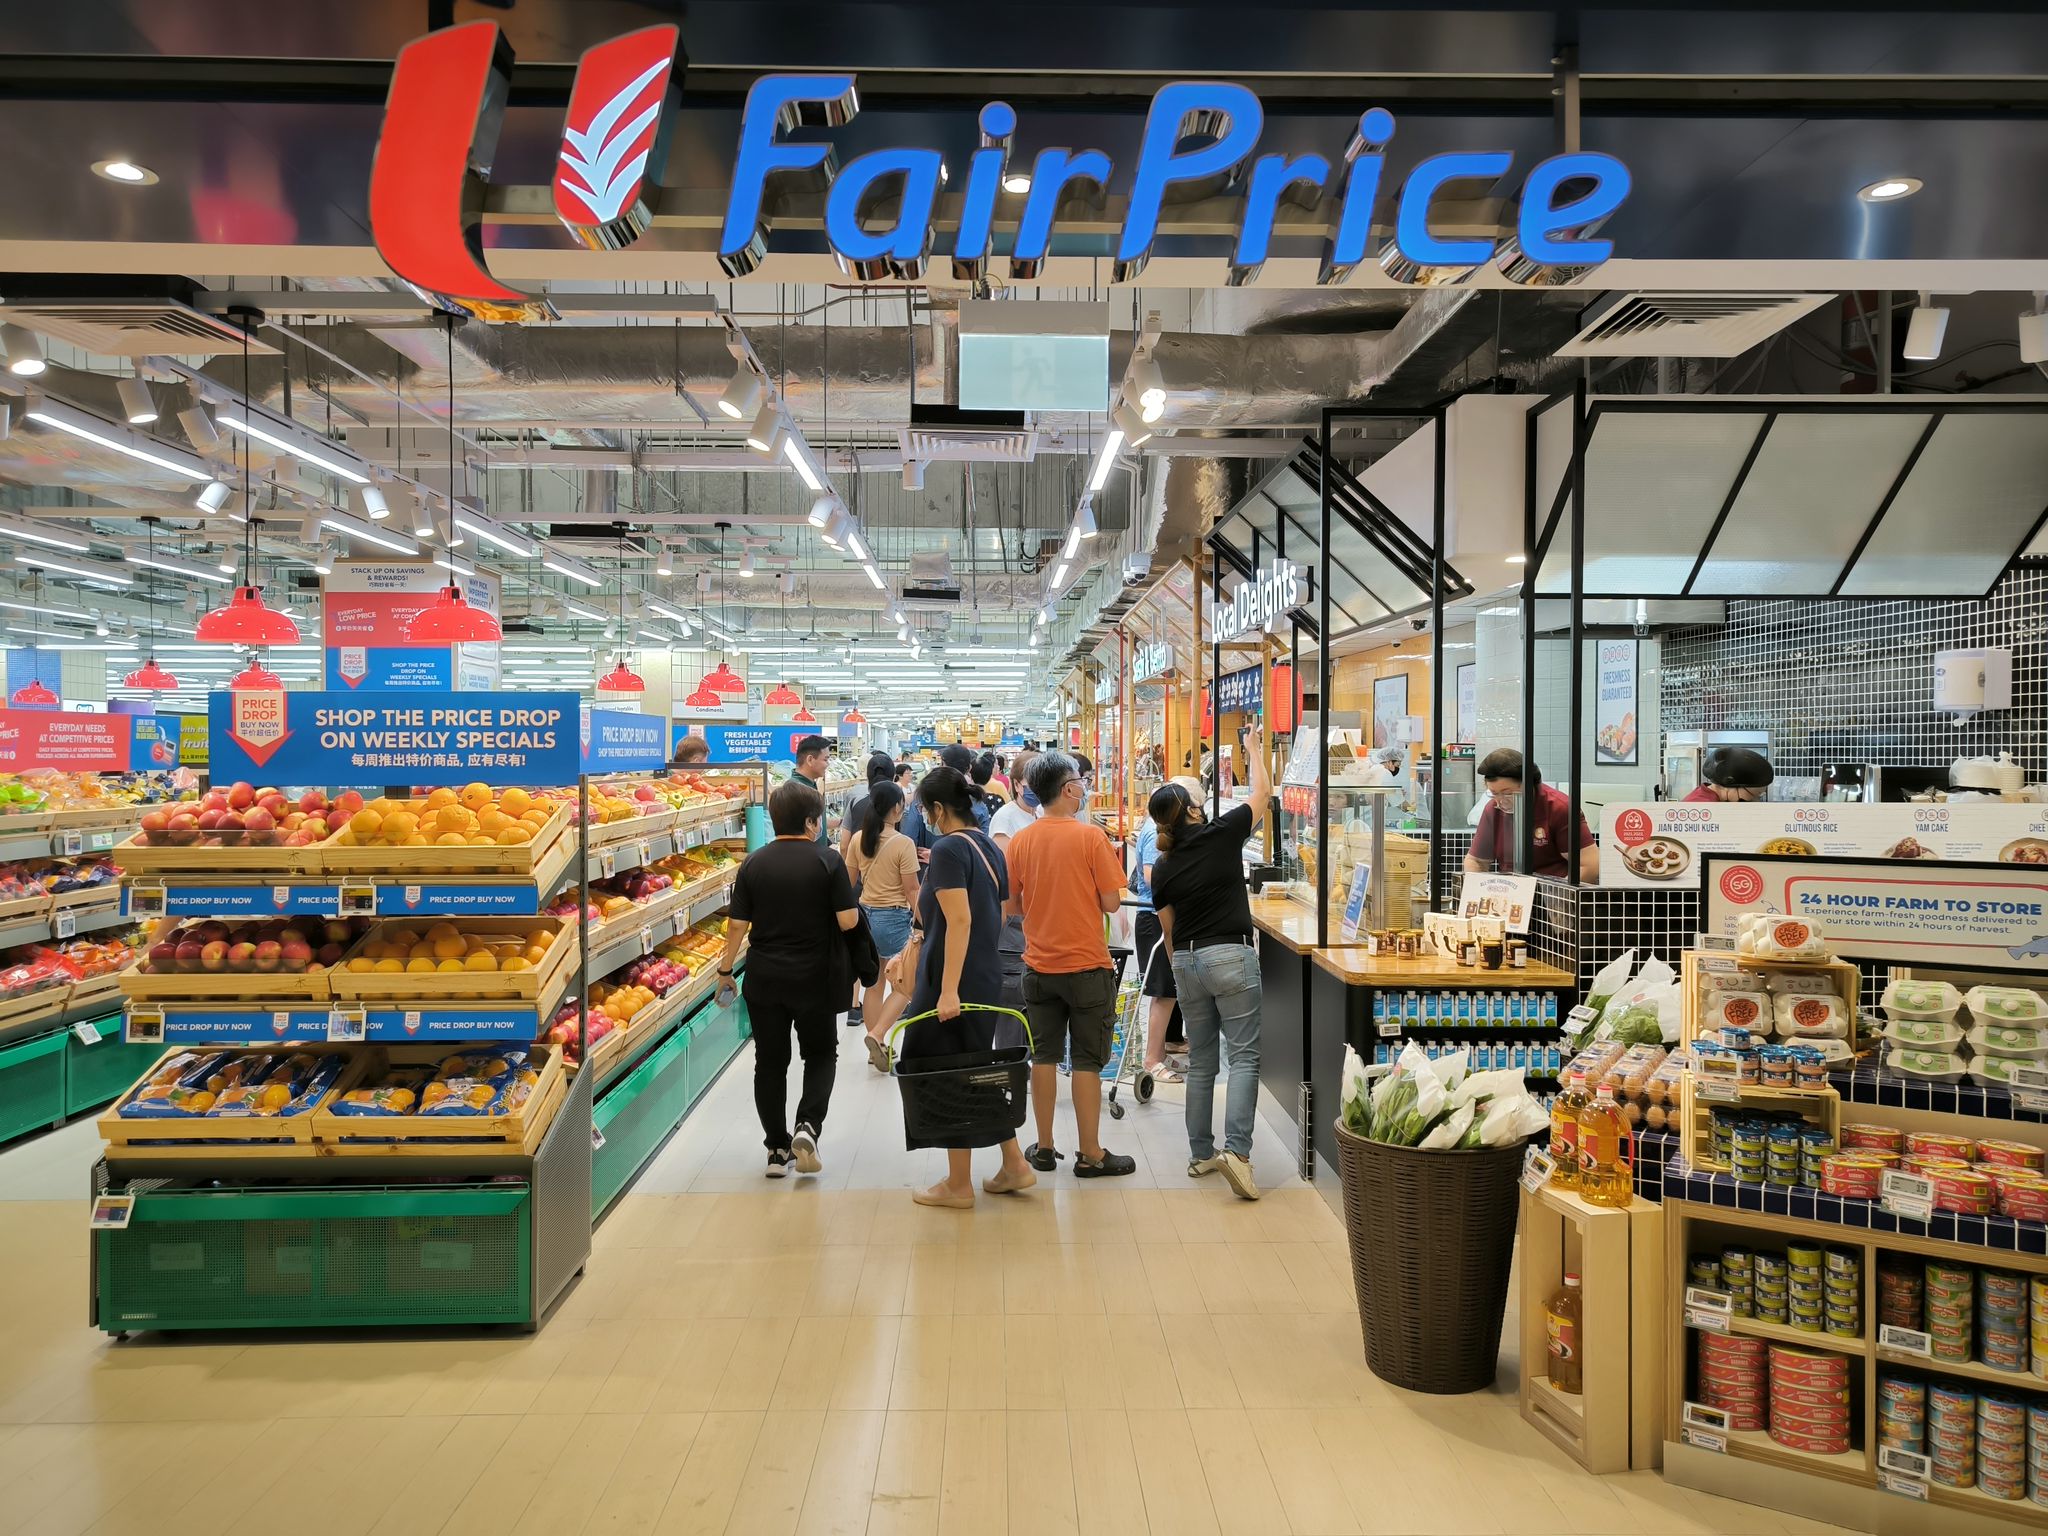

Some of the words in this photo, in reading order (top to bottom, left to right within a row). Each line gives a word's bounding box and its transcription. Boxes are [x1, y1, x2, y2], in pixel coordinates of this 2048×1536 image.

[717, 72, 1634, 275] FairPrice
[1212, 585, 1238, 644] Local
[1240, 558, 1297, 633] Delights
[339, 614, 356, 622] LOW
[357, 611, 377, 620] PRICE
[242, 699, 277, 709] PRICE
[242, 710, 278, 720] DROP
[315, 708, 376, 727] SHOP
[381, 708, 425, 727] THE
[431, 708, 492, 727] PRICE
[500, 708, 561, 727] DROP
[49, 723, 83, 733] EVERYDAY
[85, 724, 106, 733] NEEDS
[39, 734, 48, 743] AT
[49, 734, 92, 743] COMPETITIVE
[93, 735, 115, 744] PRICES
[320, 731, 356, 749] ON
[362, 731, 450, 749] WEEKLY
[456, 731, 556, 749] SPECIALS
[602, 727, 618, 743] PRICE
[620, 727, 634, 743] DROP
[635, 728, 645, 743] BUY
[645, 728, 659, 743] NOW
[351, 753, 464, 768] 每周推出特价商品,
[467, 753, 526, 767] 应有尽有!
[1657, 823, 1673, 833] JIAN
[1674, 823, 1683, 833] BO
[1684, 823, 1700, 833] SHUI
[1701, 823, 1720, 833] KUEH
[1784, 823, 1822, 833] GLUTINOUS
[1823, 823, 1838, 833] RICE
[1915, 823, 1930, 833] YAM
[1931, 823, 1949, 833] CAKE
[2029, 823, 2046, 833] CHEE
[1733, 879, 1750, 890] SG
[190, 897, 212, 905] DROP
[298, 896, 320, 904] PRICE
[1800, 893, 1822, 905] 24
[1827, 894, 1880, 908] HOUR
[1885, 896, 1938, 911] FARM
[1944, 899, 1971, 913] TO
[1976, 901, 2042, 916] STORE
[1804, 906, 1858, 917] Experience
[1861, 908, 1915, 919] farm-fresh
[1918, 911, 1969, 923] goodness
[1972, 913, 2022, 925] delivered
[2026, 917, 2038, 926] to
[1779, 927, 1798, 935] CAGE
[1845, 918, 1871, 926] store
[1874, 919, 1905, 928] within
[1908, 921, 1920, 929] 24
[1923, 922, 1953, 931] hours
[1955, 923, 1966, 931] of
[1969, 924, 2013, 934] harvest.
[1780, 932, 1805, 943] FREE
[1729, 1002, 1748, 1010] CAGE
[1799, 1003, 1818, 1011] CAGE
[1730, 1008, 1753, 1021] FREE
[1799, 1009, 1825, 1021] FREE
[166, 1023, 188, 1031] PRICE
[189, 1023, 212, 1031] DROP
[214, 1023, 229, 1031] BUY
[231, 1023, 252, 1031] NOW
[297, 1022, 320, 1030] PRICE
